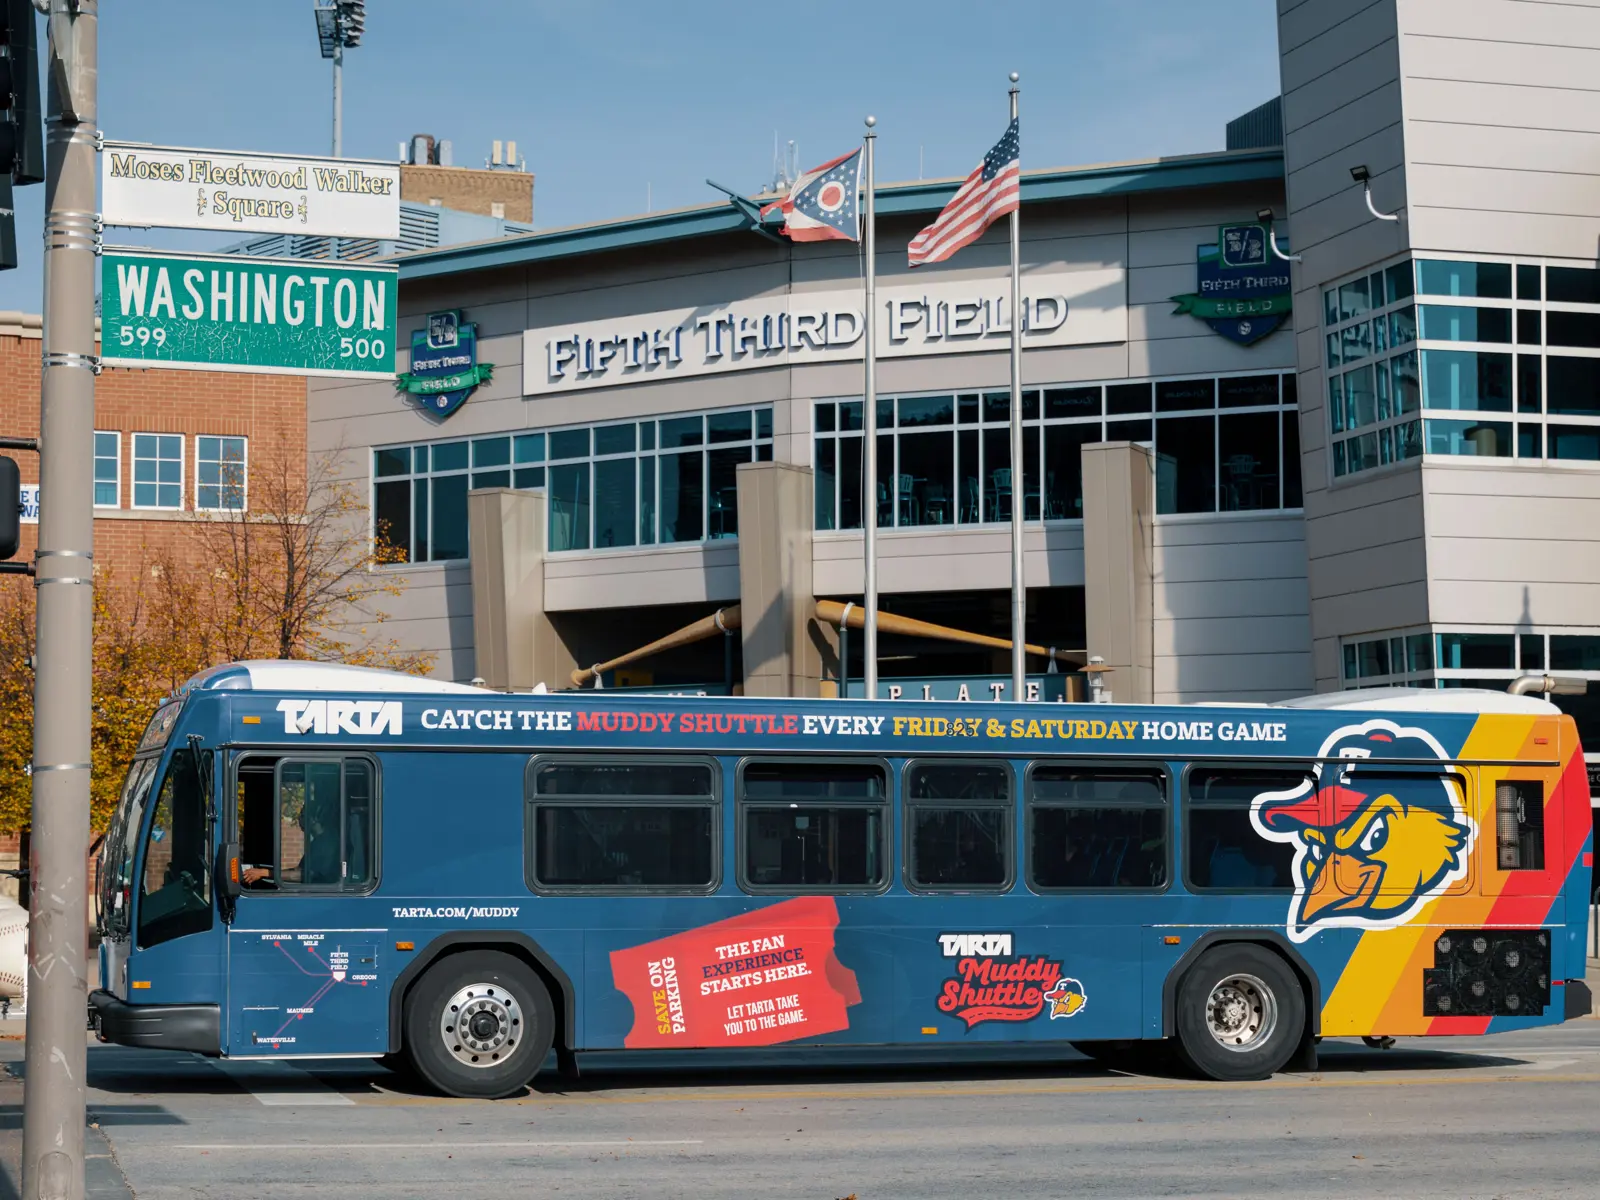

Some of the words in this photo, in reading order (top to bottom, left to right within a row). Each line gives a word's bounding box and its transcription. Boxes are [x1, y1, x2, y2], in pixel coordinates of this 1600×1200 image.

[110, 153, 184, 182] Moses
[189, 159, 307, 190] Fleetwood
[313, 167, 393, 195] Walker
[213, 191, 293, 222] Square
[117, 264, 386, 331] WASHINGTON
[1201, 279, 1240, 291] FIFTH
[1243, 276, 1289, 288] THIRD
[1216, 300, 1272, 312] FIELD
[119, 326, 166, 347] 599
[340, 337, 385, 359] 500
[547, 326, 683, 377] FIFTH
[696, 305, 865, 357] THIRD
[890, 295, 1068, 341] FIELD
[276, 699, 402, 735] TARTA
[421, 708, 513, 731] CATCH
[518, 710, 572, 731] THE
[576, 711, 675, 733] MUDDY
[679, 713, 798, 735] SHUTTLE
[803, 715, 885, 736] EVERY
[893, 717, 983, 737] FRIDAY
[986, 718, 1006, 737] &
[1010, 719, 1138, 740] SATURDAY
[1142, 722, 1213, 741] HOME
[1218, 722, 1287, 742] GAME
[946, 722, 975, 737] 825
[392, 906, 520, 920] TARTA.COM/MUDDY
[715, 944, 750, 960] THE
[751, 935, 785, 952] FAN
[938, 934, 1012, 956] TARTA
[648, 961, 664, 988] ON
[702, 947, 804, 979] EXPERIENCE
[958, 958, 1061, 991] Muddy
[662, 956, 686, 1034] PARKING
[700, 972, 763, 996] STARTS
[764, 963, 812, 984] HERE.
[727, 1005, 745, 1020] LET
[745, 1001, 775, 1017] TARTA
[775, 994, 800, 1011] TAKE
[938, 980, 1043, 1012] Shuttle
[652, 989, 672, 1035] SAVE
[724, 1021, 744, 1036] YOU
[745, 1019, 757, 1033] TO
[758, 1014, 778, 1030] THE
[778, 1009, 807, 1026] GAME.
